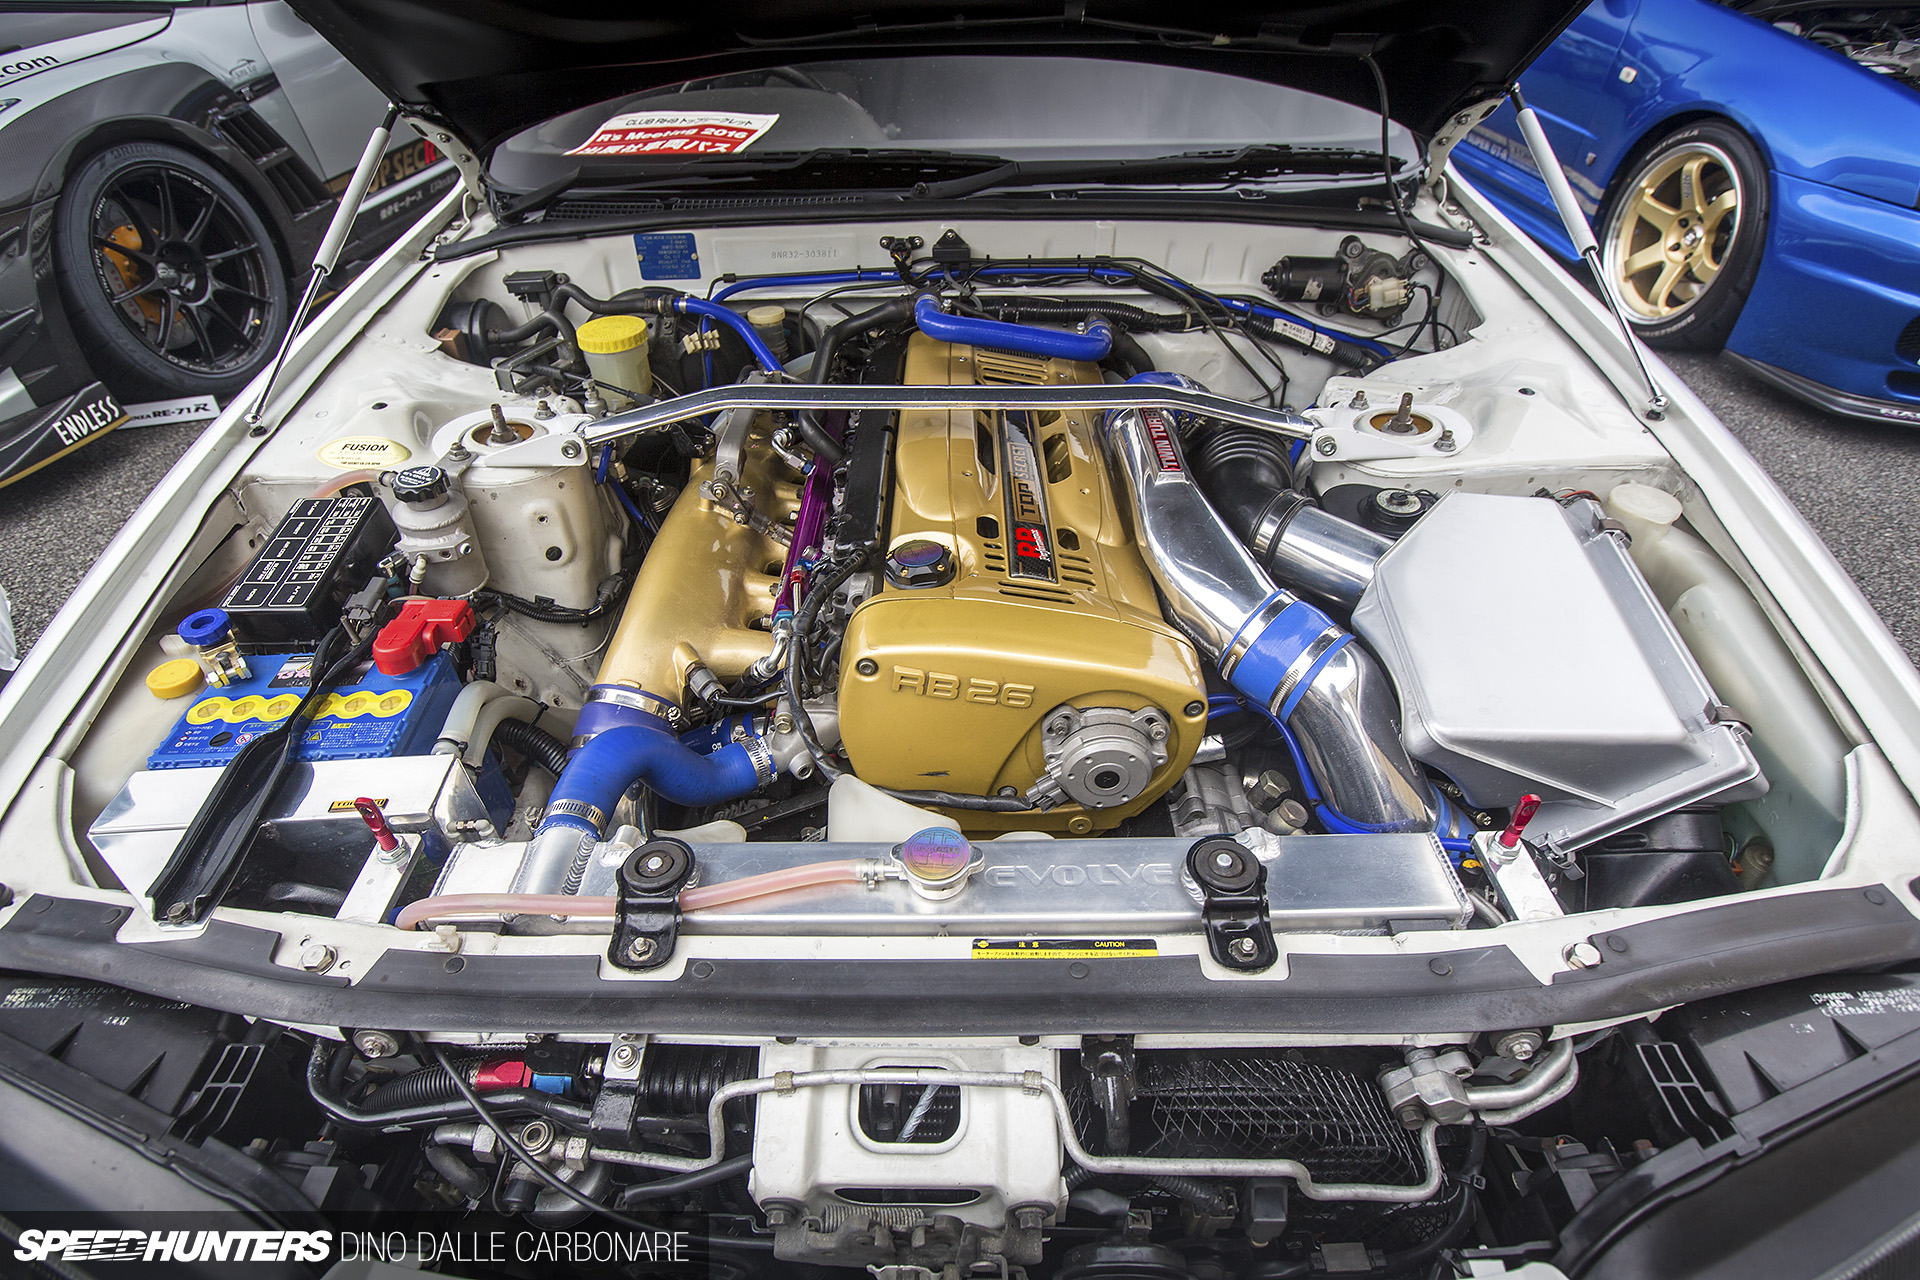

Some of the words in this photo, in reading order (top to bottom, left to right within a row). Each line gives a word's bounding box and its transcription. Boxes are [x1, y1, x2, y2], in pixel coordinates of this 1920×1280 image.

[595, 133, 623, 142] R's
[624, 128, 699, 141] Meeting
[700, 127, 748, 139] 2016
[625, 118, 654, 126] CLUB
[52, 395, 120, 446] ENDLESS
[341, 443, 389, 452] FUSION
[1154, 440, 1179, 468] TWIN
[1012, 445, 1029, 480] SECRET
[1018, 482, 1036, 516] TOP
[1016, 527, 1045, 558] RB
[891, 665, 960, 700] RB
[966, 677, 1035, 708] 26
[984, 863, 1175, 887] EVOLVE
[1094, 941, 1126, 949] CAUTION
